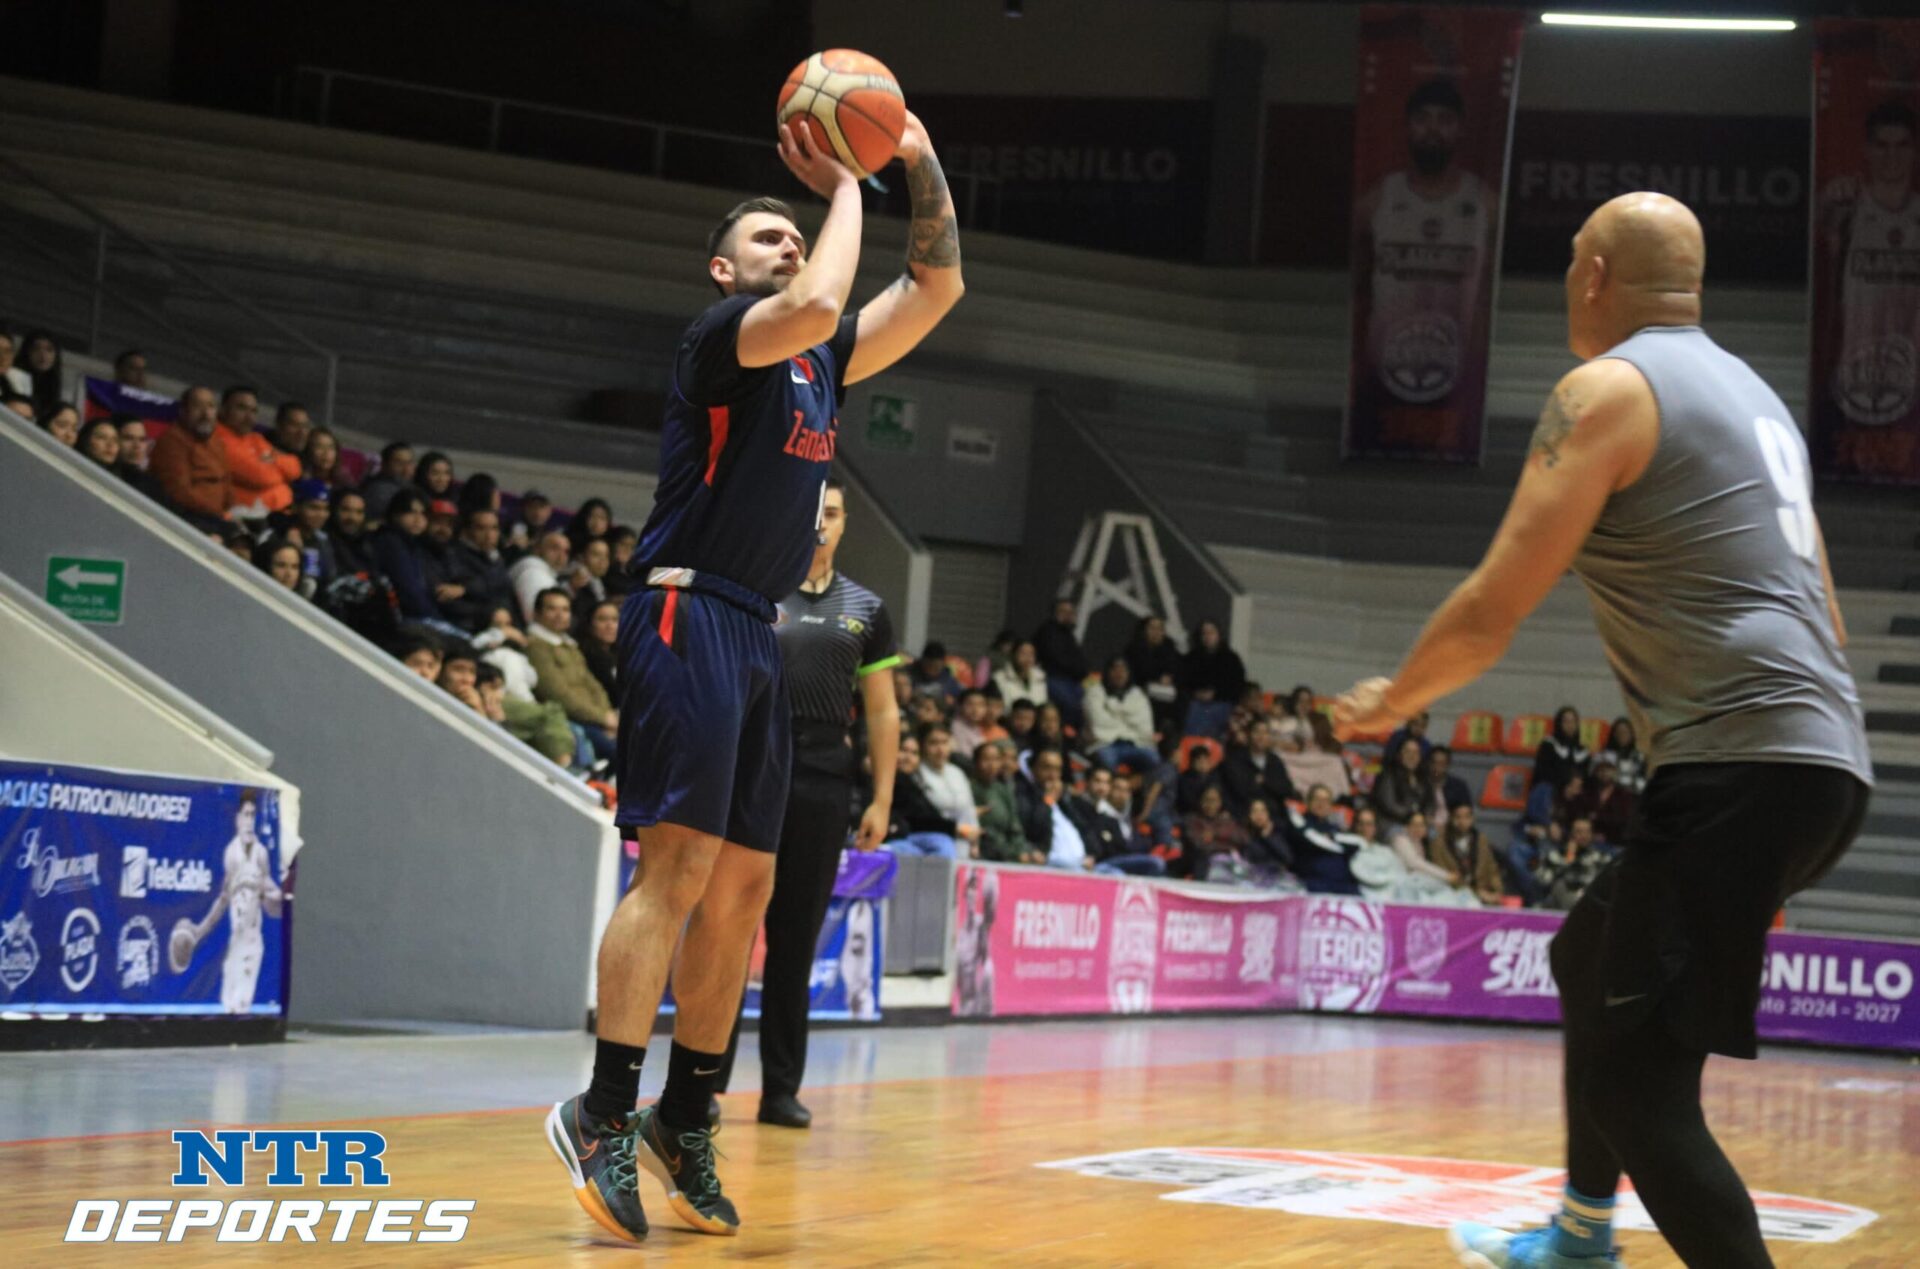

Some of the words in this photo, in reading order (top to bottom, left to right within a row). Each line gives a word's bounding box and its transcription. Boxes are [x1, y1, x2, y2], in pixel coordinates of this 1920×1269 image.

[946, 144, 1179, 182] FRESNILLO
[1519, 160, 1802, 207] FRESNILLO
[1753, 416, 1815, 558] 9
[48, 783, 192, 823] PATROCINADORES!
[148, 857, 212, 892] TeleCable
[1012, 899, 1101, 951] FRESNILLO
[1789, 997, 1837, 1018] 2024
[1854, 1001, 1902, 1023] 2027
